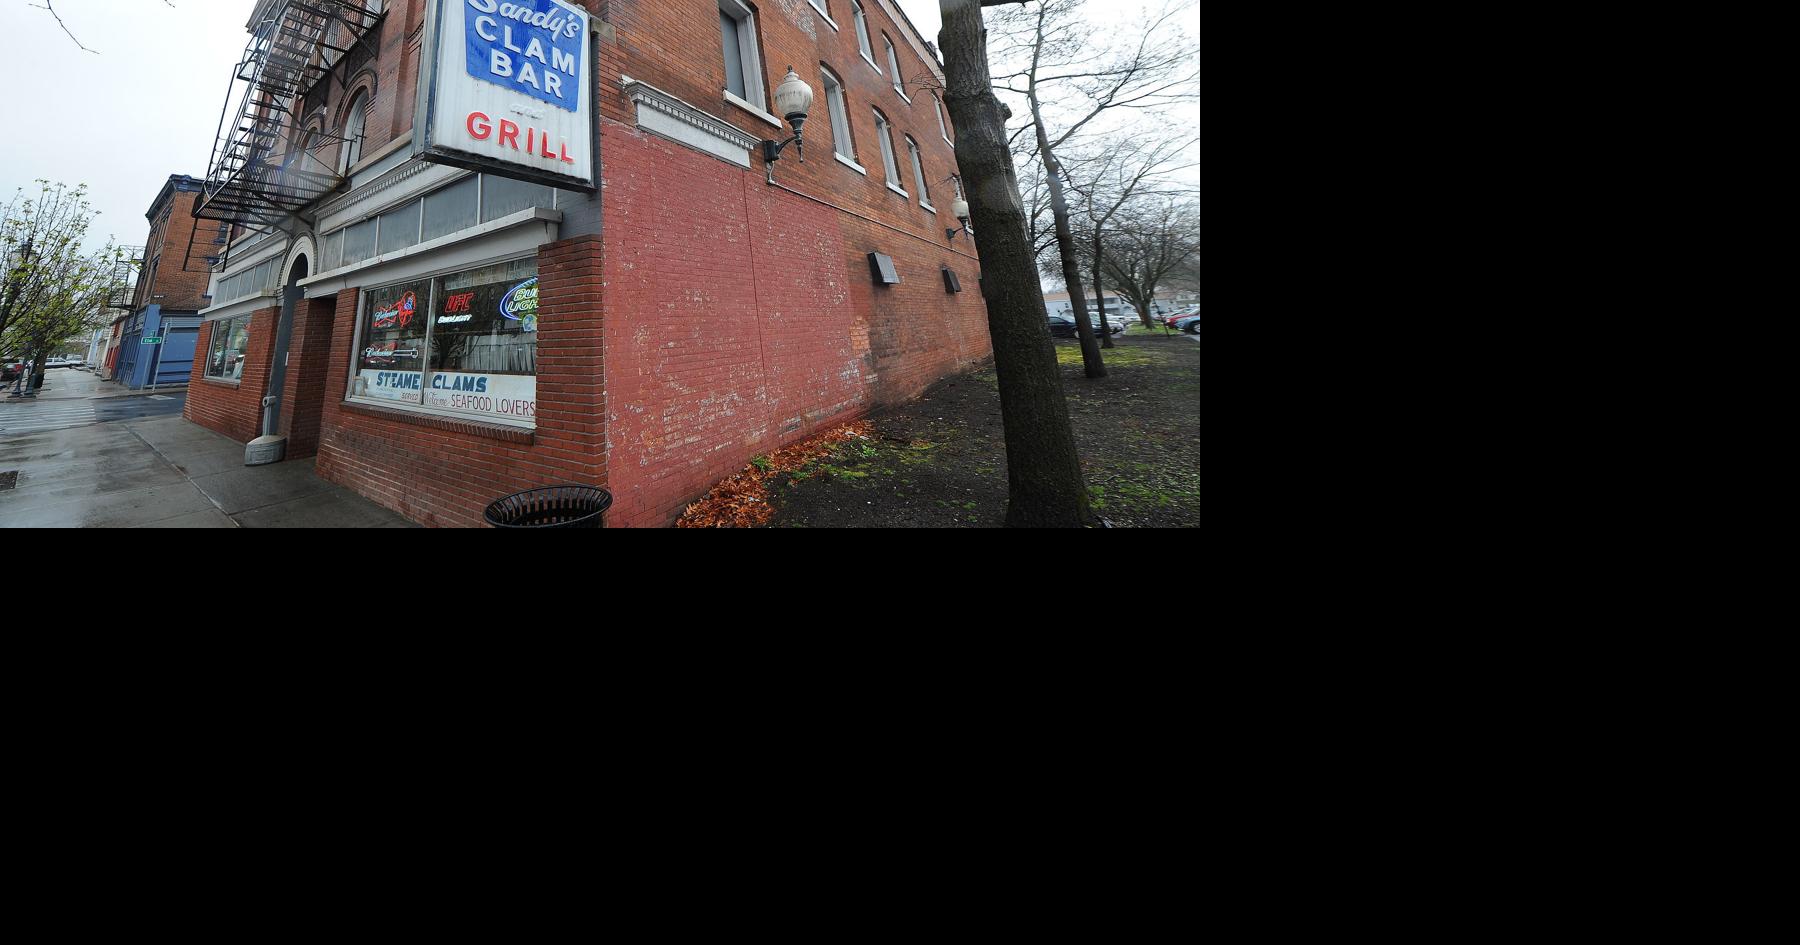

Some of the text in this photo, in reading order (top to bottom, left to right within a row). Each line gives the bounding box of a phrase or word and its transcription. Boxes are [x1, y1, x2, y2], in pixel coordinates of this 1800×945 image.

[475, 16, 575, 76] CLAM
[491, 49, 563, 98] BAR
[466, 111, 575, 164] GRILL
[445, 292, 474, 312] UFC
[506, 299, 538, 313] LIGH
[376, 371, 488, 393] STEAME CLAMS
[451, 393, 492, 412] SEAFOOD
[496, 398, 537, 417] LOVERS
